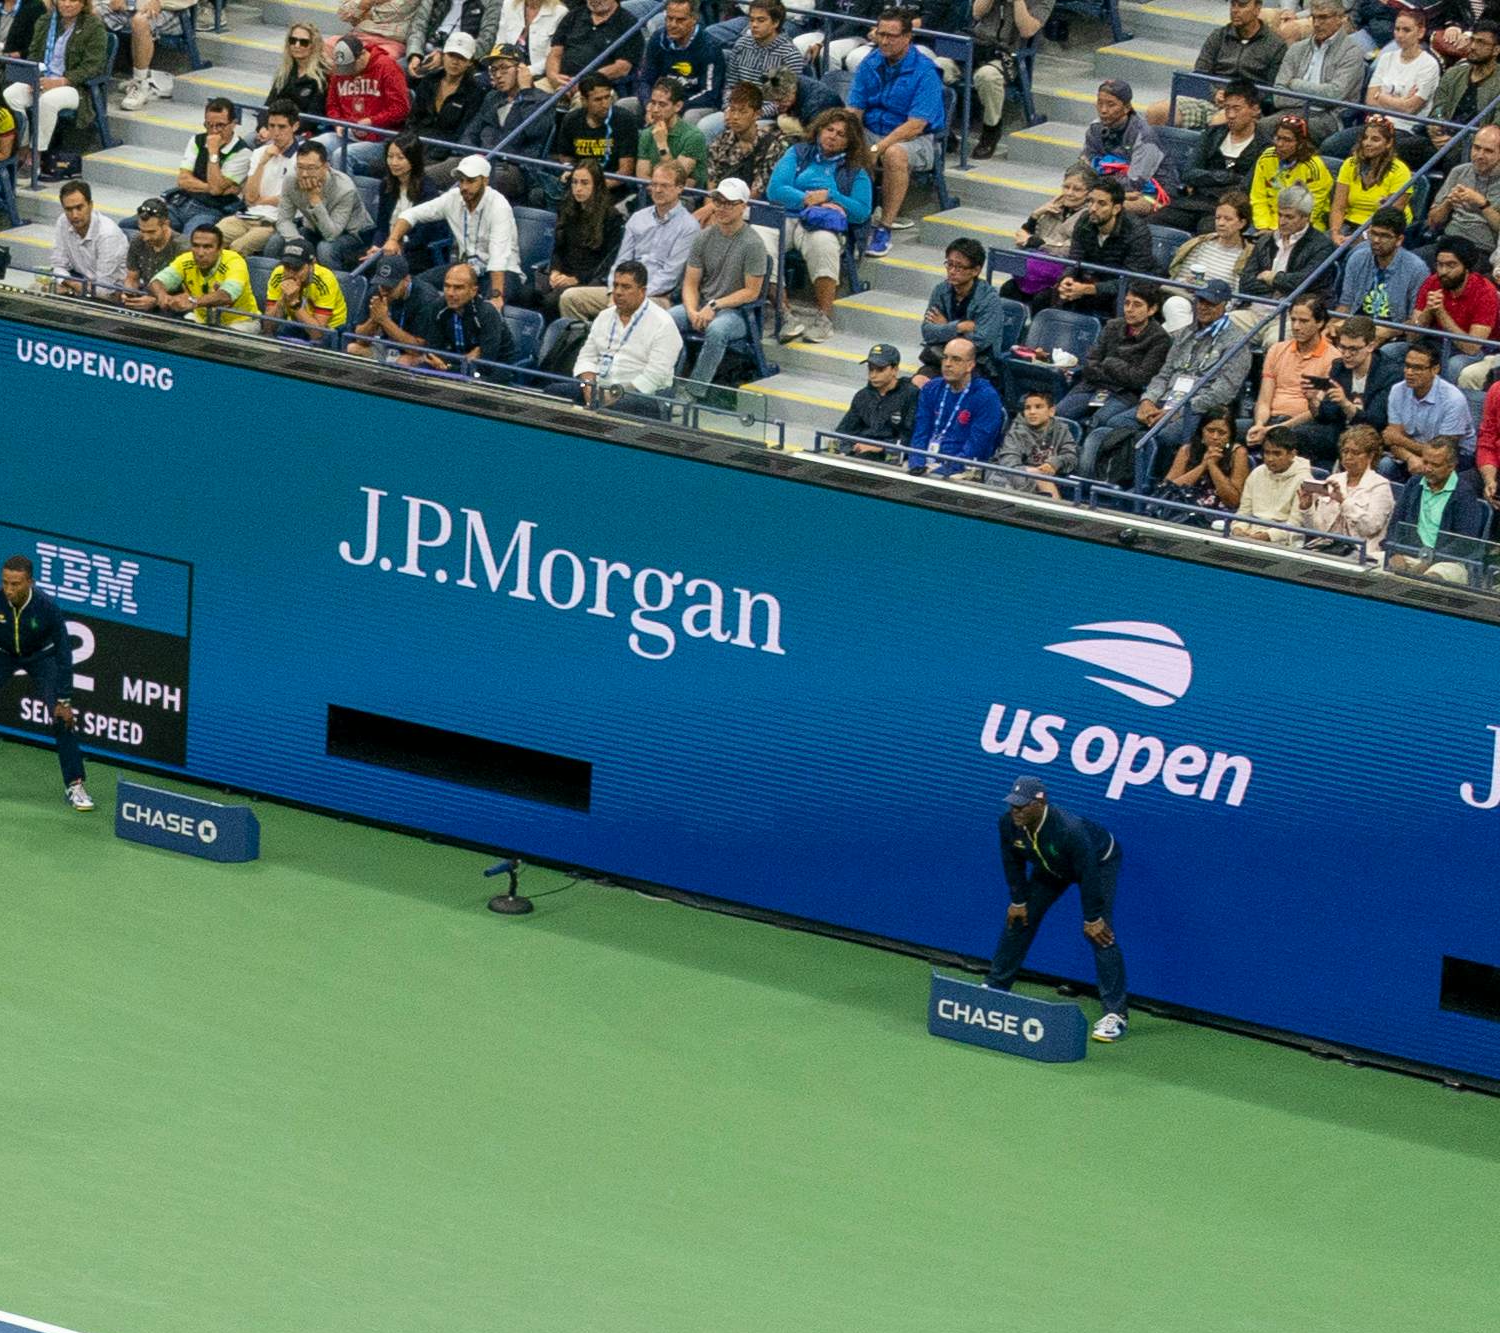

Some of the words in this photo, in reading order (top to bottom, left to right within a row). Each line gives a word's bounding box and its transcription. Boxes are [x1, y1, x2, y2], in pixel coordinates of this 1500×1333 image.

[16, 337, 175, 392] USOPEN.ORG
[35, 541, 140, 615] IBM
[338, 485, 785, 661] J.P.Morgan
[122, 676, 181, 712] MPH
[83, 712, 143, 745] SPEED
[980, 702, 1066, 765] us
[1070, 722, 1253, 808] open
[121, 800, 195, 838] CHASE
[937, 998, 1019, 1036] CHASE
